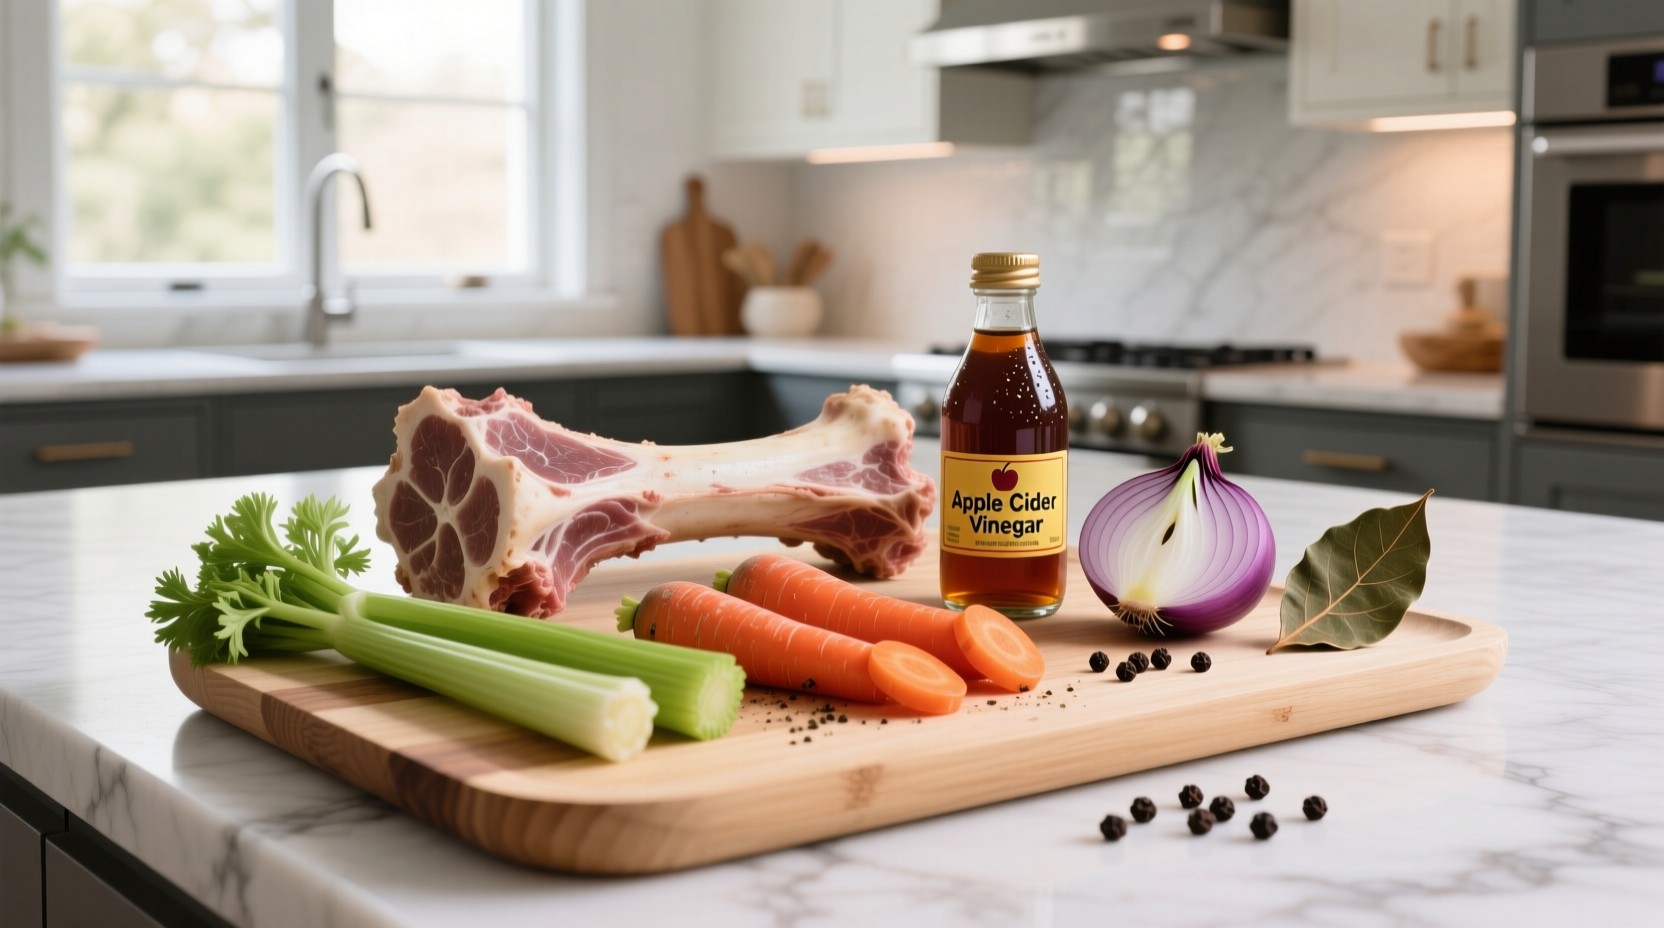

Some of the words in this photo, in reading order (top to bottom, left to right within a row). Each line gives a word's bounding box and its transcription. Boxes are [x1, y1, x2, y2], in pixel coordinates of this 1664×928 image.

[952, 490, 1003, 515] Apple
[1009, 492, 1057, 512] Cider
[969, 515, 1044, 539] Vinegar
